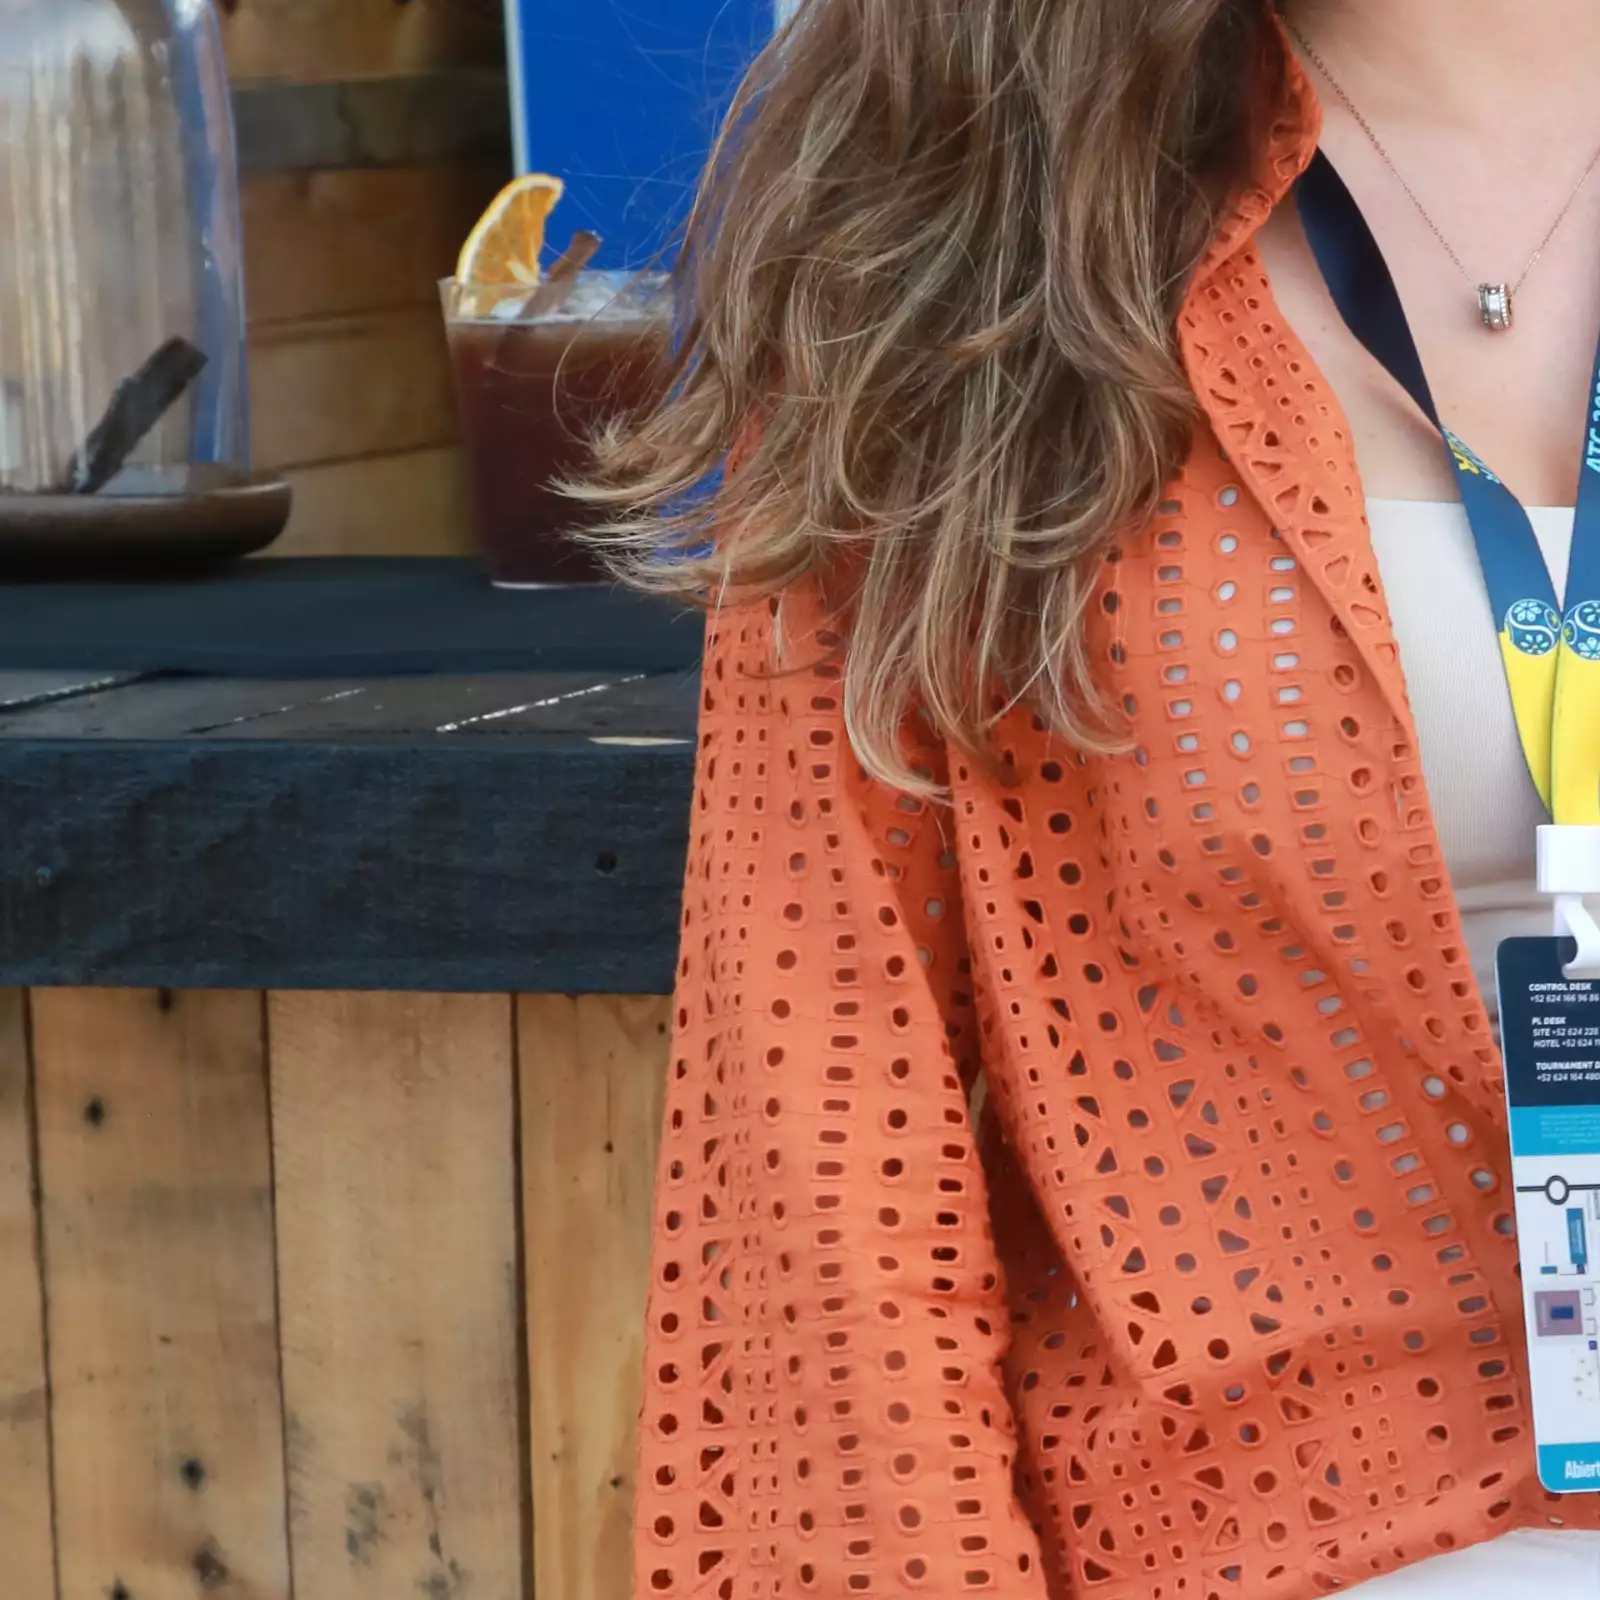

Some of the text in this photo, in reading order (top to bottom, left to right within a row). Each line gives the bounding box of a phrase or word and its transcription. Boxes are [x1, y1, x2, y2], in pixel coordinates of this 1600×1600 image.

[1528, 982, 1592, 992] CONTROL DESK
[1545, 994, 1561, 1003] 624
[1543, 1016, 1566, 1025] DESK
[1532, 1028, 1550, 1037] SITE
[1567, 1028, 1582, 1037] 624
[1533, 1039, 1561, 1048] HOTEL
[1577, 1039, 1593, 1047] 624
[1536, 1061, 1594, 1070] TOURNAMENT
[1552, 1073, 1568, 1081] 624
